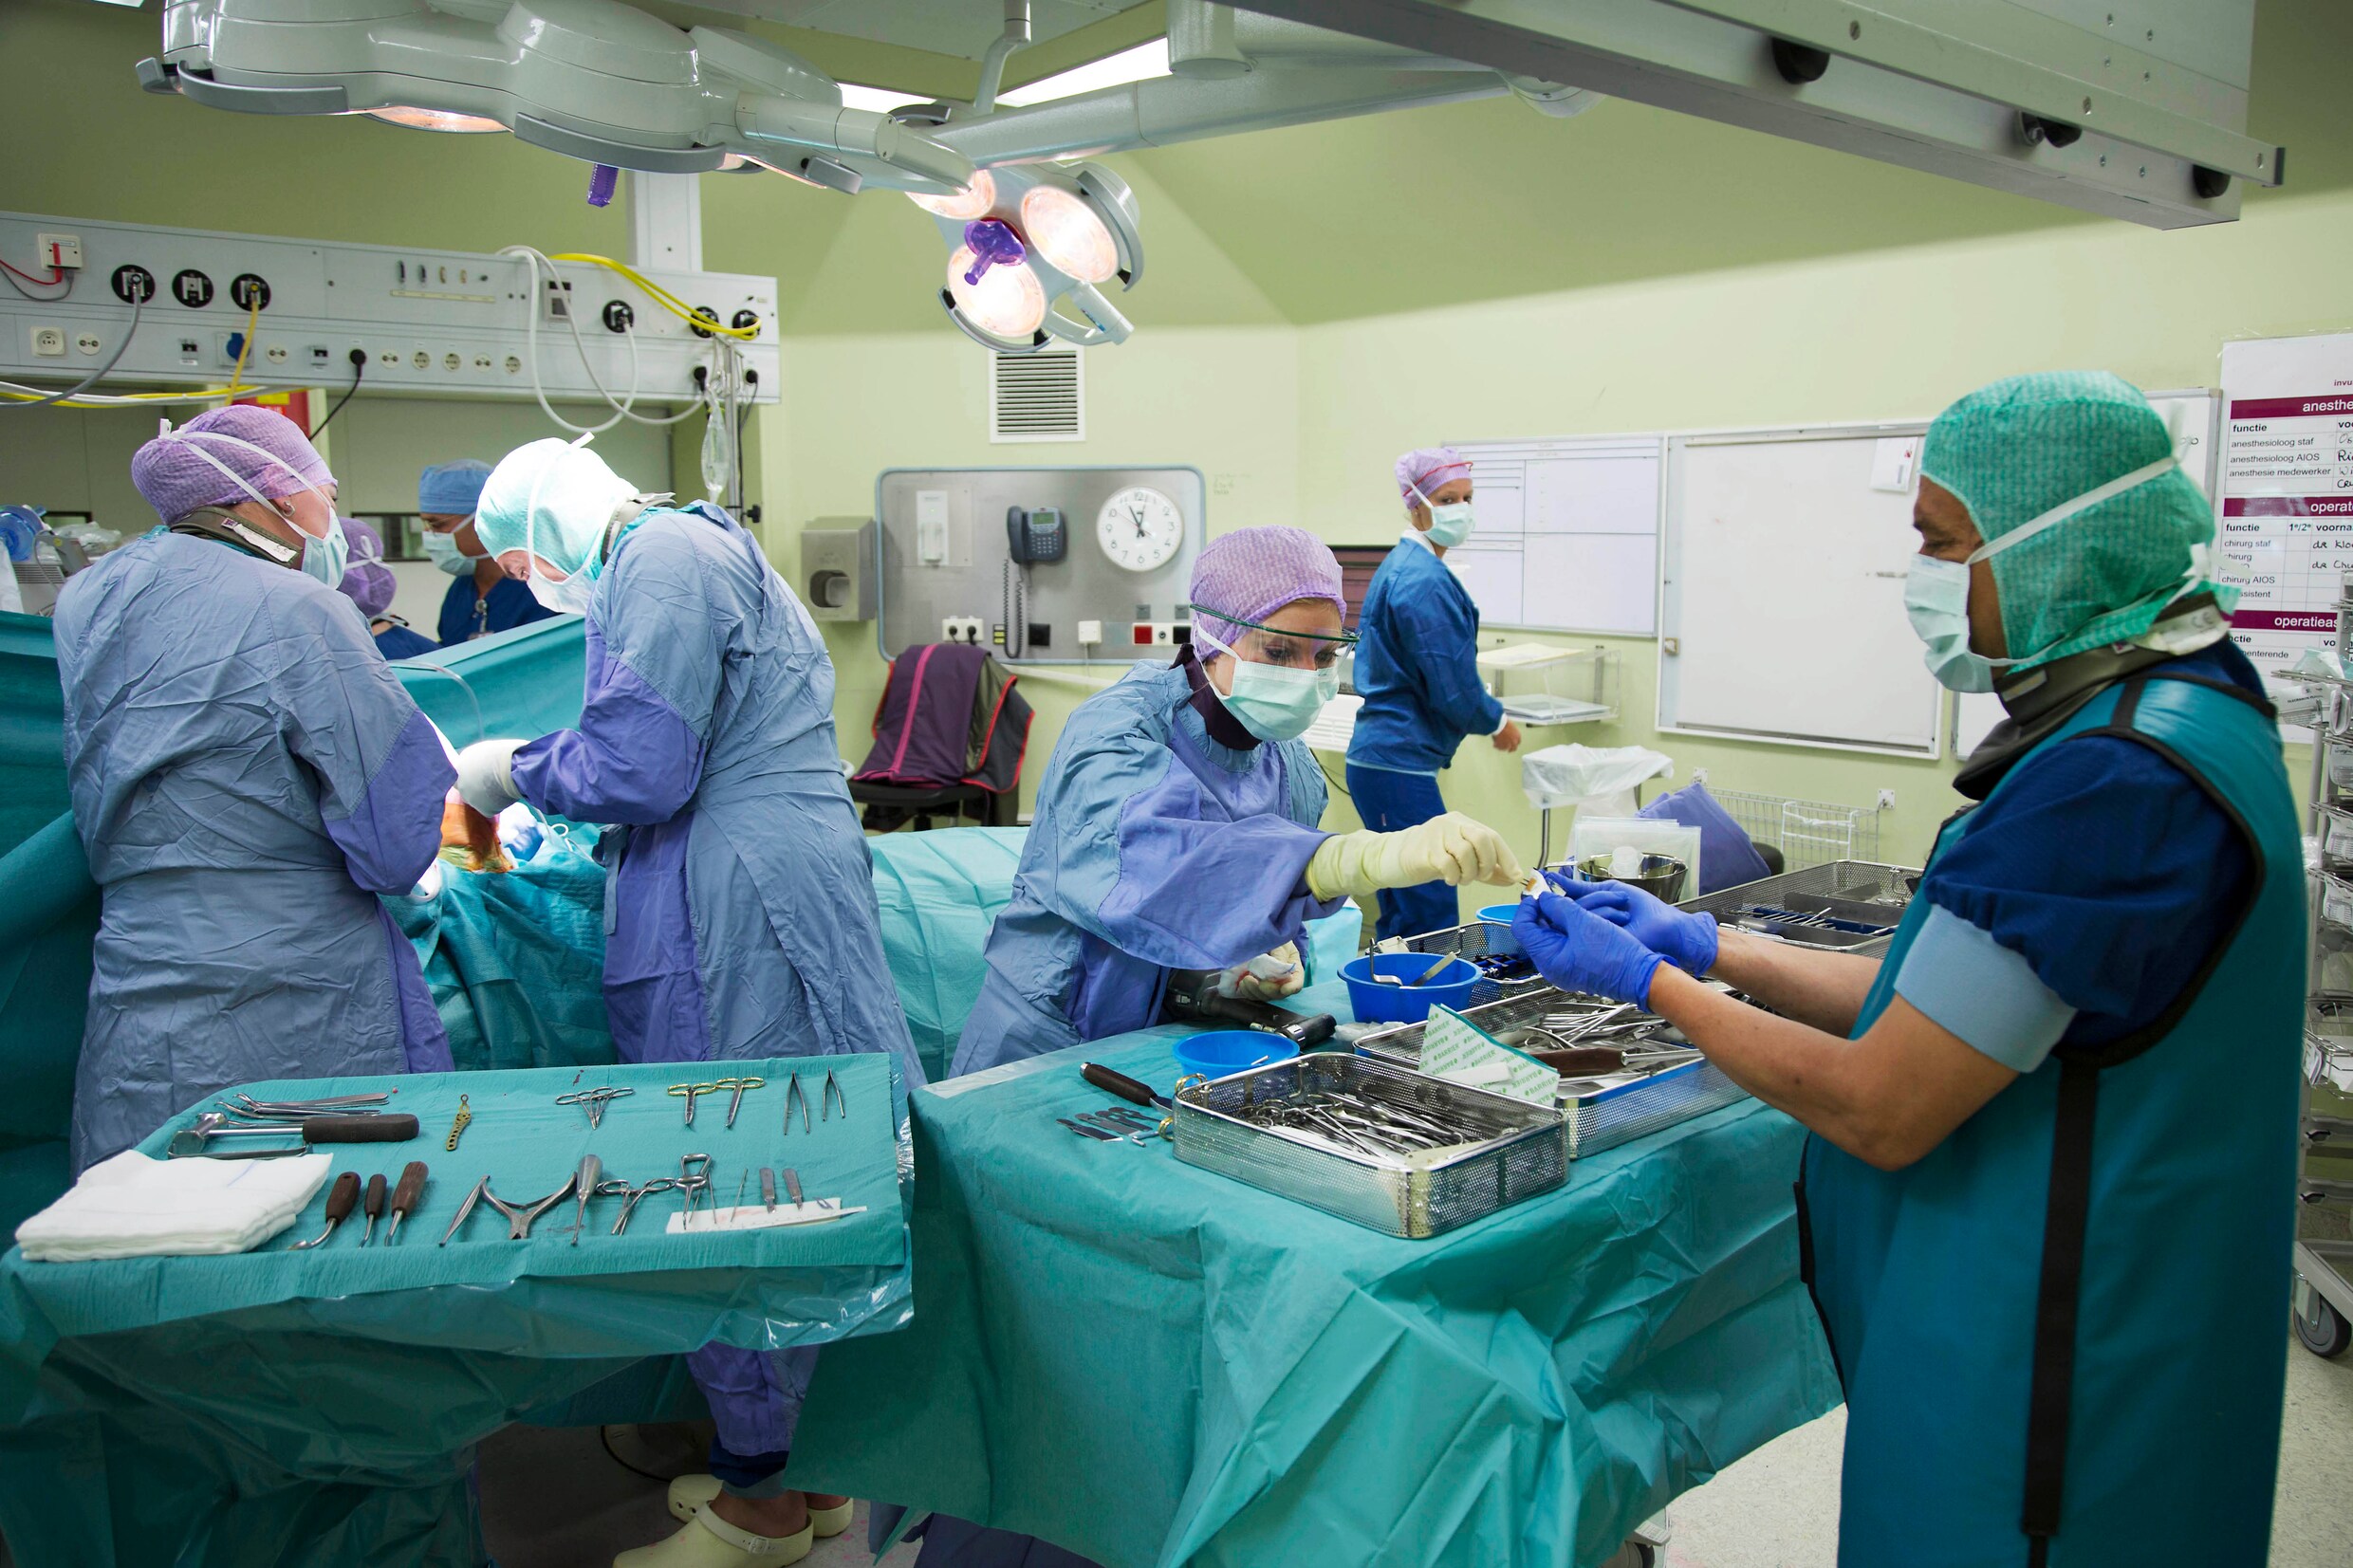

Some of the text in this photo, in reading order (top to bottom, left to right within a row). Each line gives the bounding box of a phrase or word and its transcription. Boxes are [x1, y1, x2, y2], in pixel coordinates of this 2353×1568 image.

[2233, 424, 2268, 433] functie
[2231, 437, 2314, 448] anesthesioloog staf
[2230, 453, 2320, 463] anesthesioloog AIOS
[2229, 467, 2331, 477] anesthesie medewerker
[2226, 524, 2260, 532] functie
[2224, 540, 2253, 548] chirurg
[2221, 576, 2275, 584] chirurg AIOS
